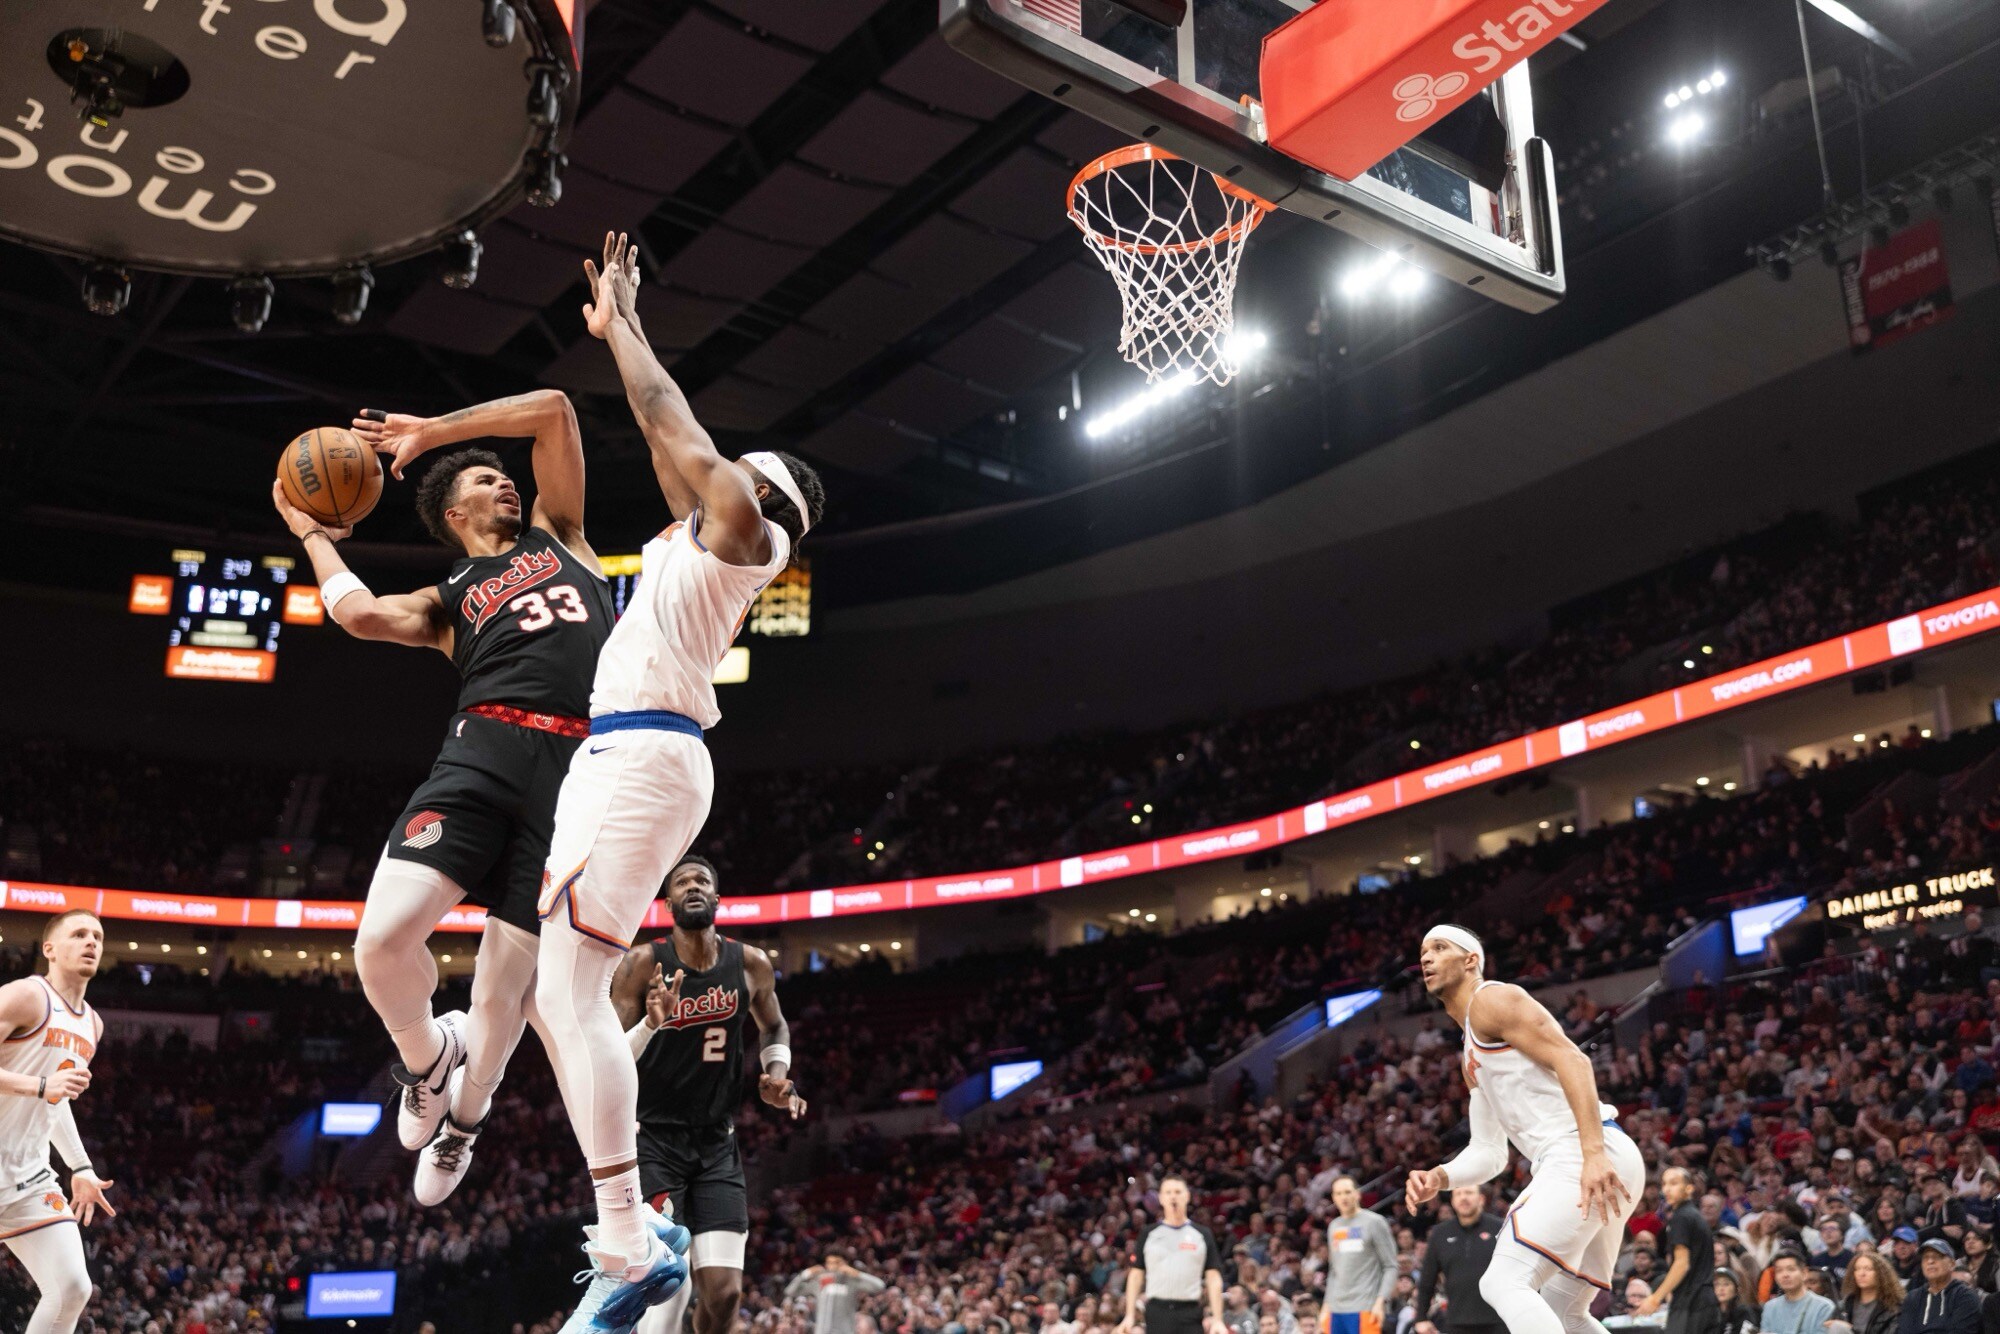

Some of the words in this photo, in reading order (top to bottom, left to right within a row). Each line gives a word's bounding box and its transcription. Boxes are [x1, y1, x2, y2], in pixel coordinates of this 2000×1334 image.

[1452, 0, 1587, 73] Stat
[296, 433, 322, 497] Wilson
[461, 546, 563, 635] ripcity
[509, 585, 590, 632] 33
[1925, 601, 1998, 635] TOYOTA
[1710, 657, 1813, 702] TOYOTA.COM
[1586, 710, 1645, 739] TOYOTA
[1422, 754, 1503, 790] TOYOTA.COM
[1326, 794, 1373, 819] TOYOTA
[1181, 829, 1260, 856] TOYOTA.COM
[1084, 854, 1131, 875] TOYOTA
[10, 887, 66, 906] TOYOTA
[834, 891, 882, 908] TOYOTA
[935, 877, 1014, 898] TOYOTA.COM
[1827, 884, 1919, 918] DAIMLER
[1925, 868, 1995, 897] TRUCK
[131, 898, 218, 918] TOYOTA.COM
[303, 907, 357, 922] TOYOTA
[660, 984, 739, 1031] pcity
[702, 1027, 728, 1062] 2
